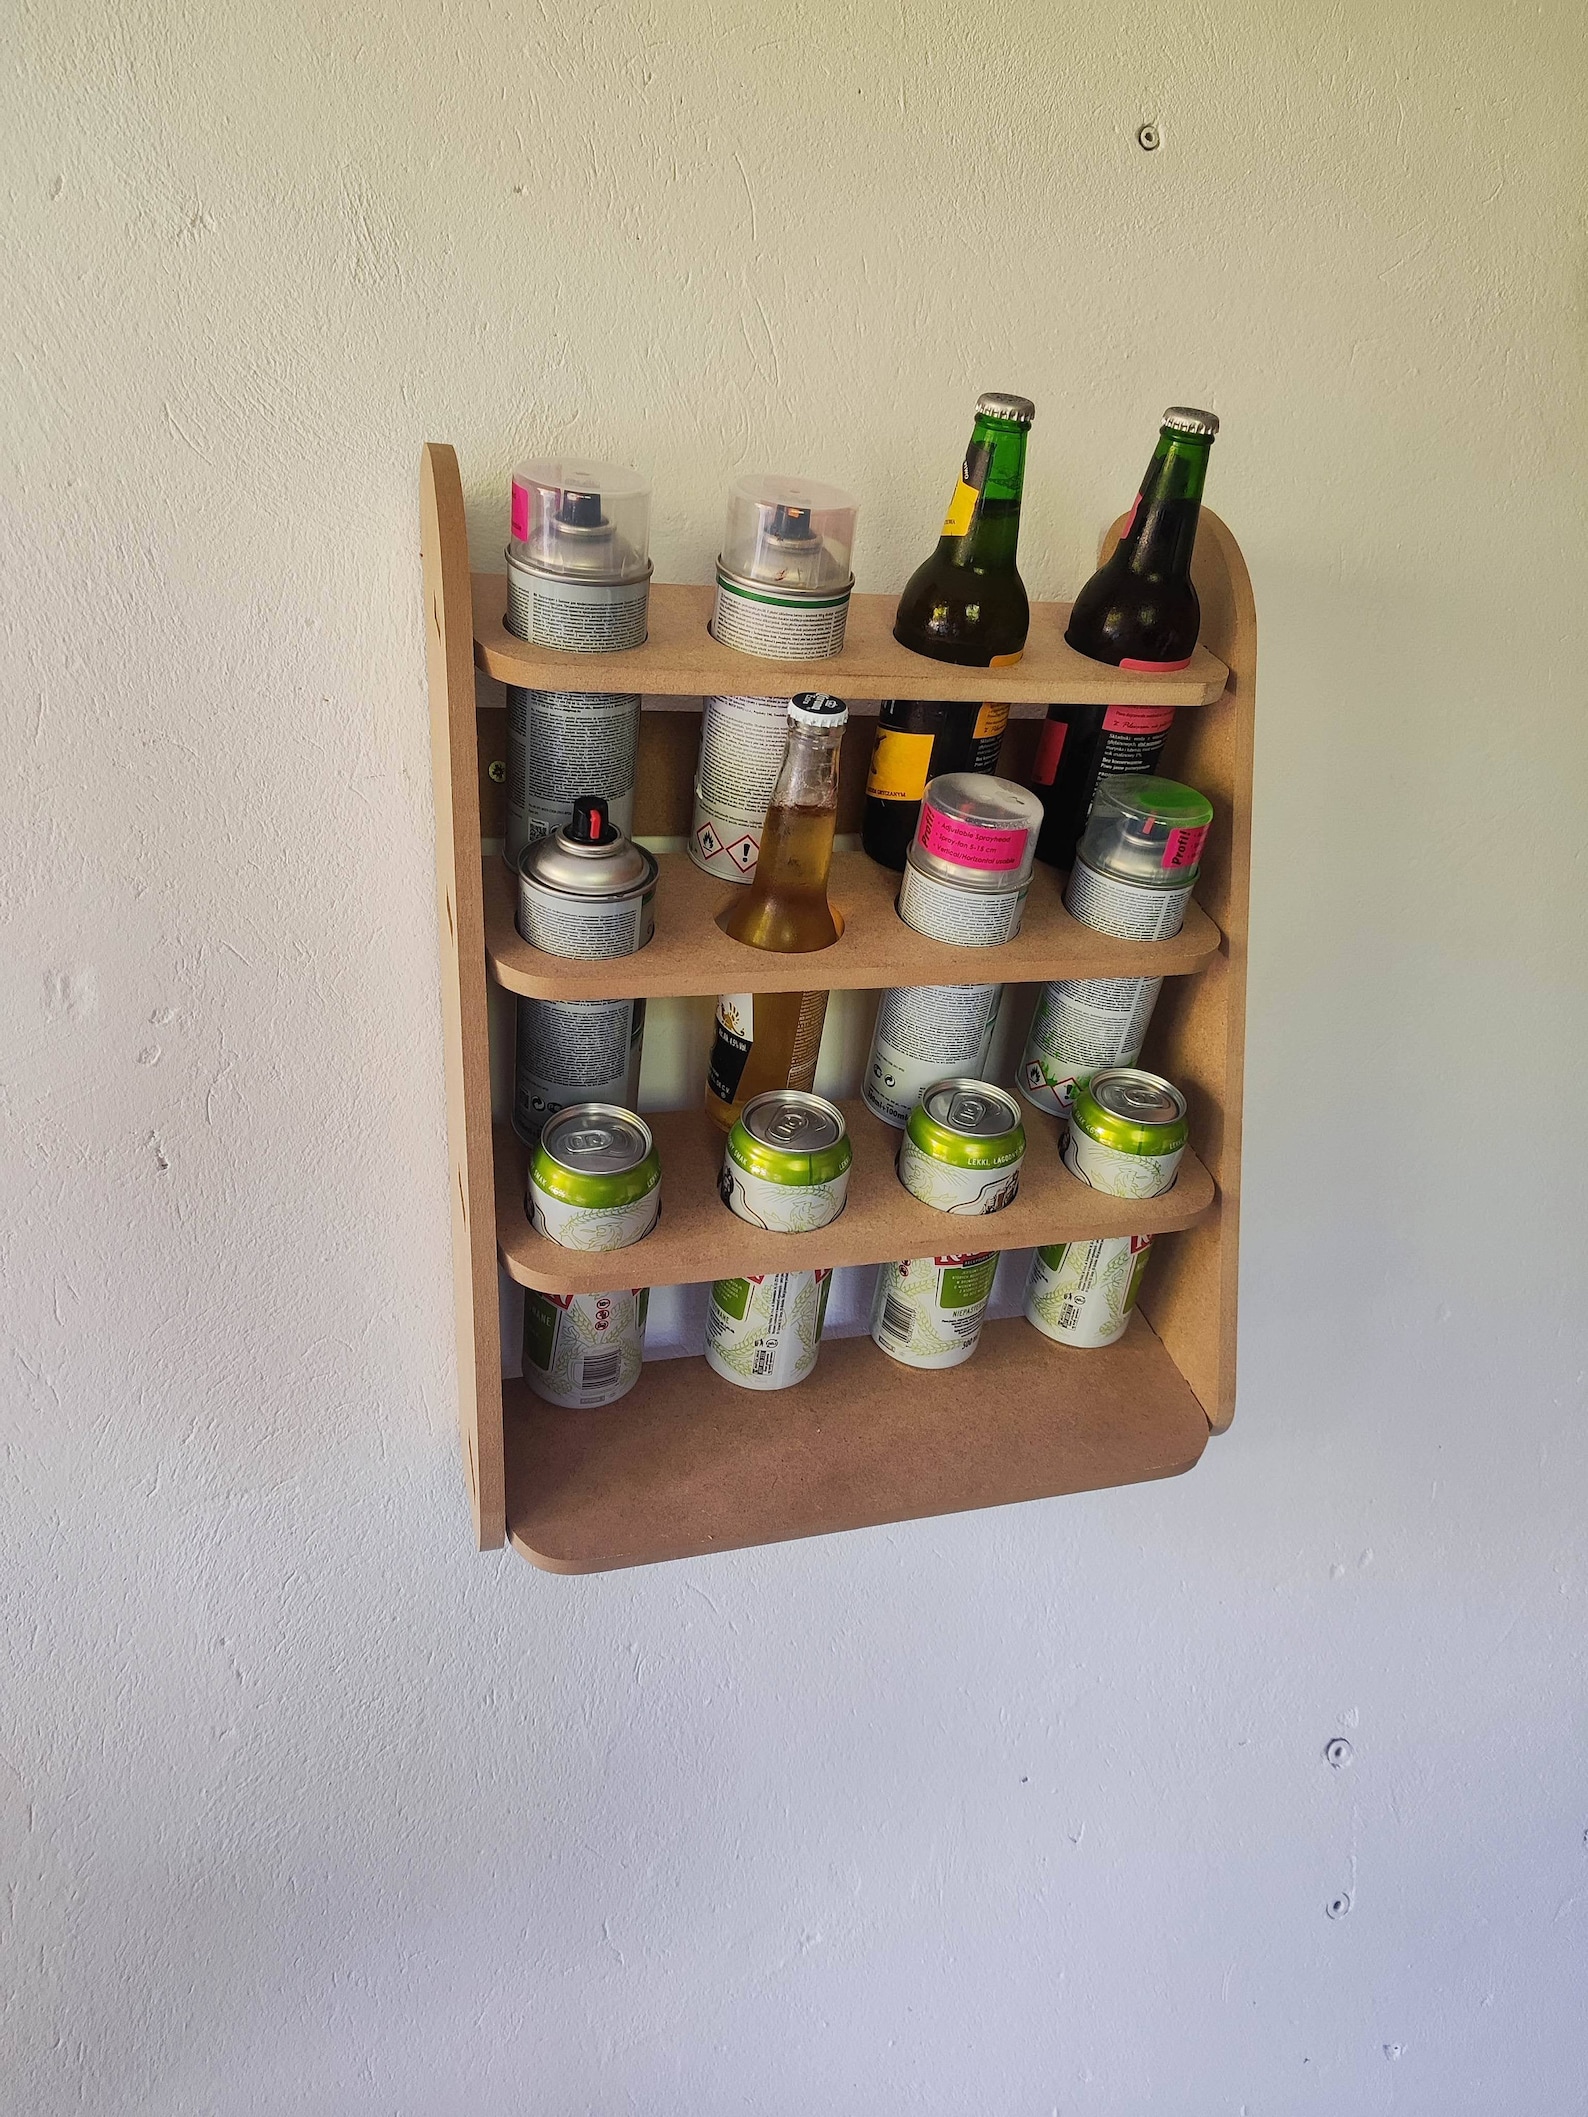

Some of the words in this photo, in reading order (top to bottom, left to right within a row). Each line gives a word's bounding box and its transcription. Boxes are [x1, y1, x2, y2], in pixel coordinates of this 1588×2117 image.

[941, 822, 974, 839] Adjustable
[975, 832, 1011, 843] Sprayhead
[938, 833, 968, 849] Spray-fan
[969, 844, 985, 853] 5-15
[1171, 830, 1191, 866] Profi!
[937, 845, 995, 864] Vertical/Horizontal
